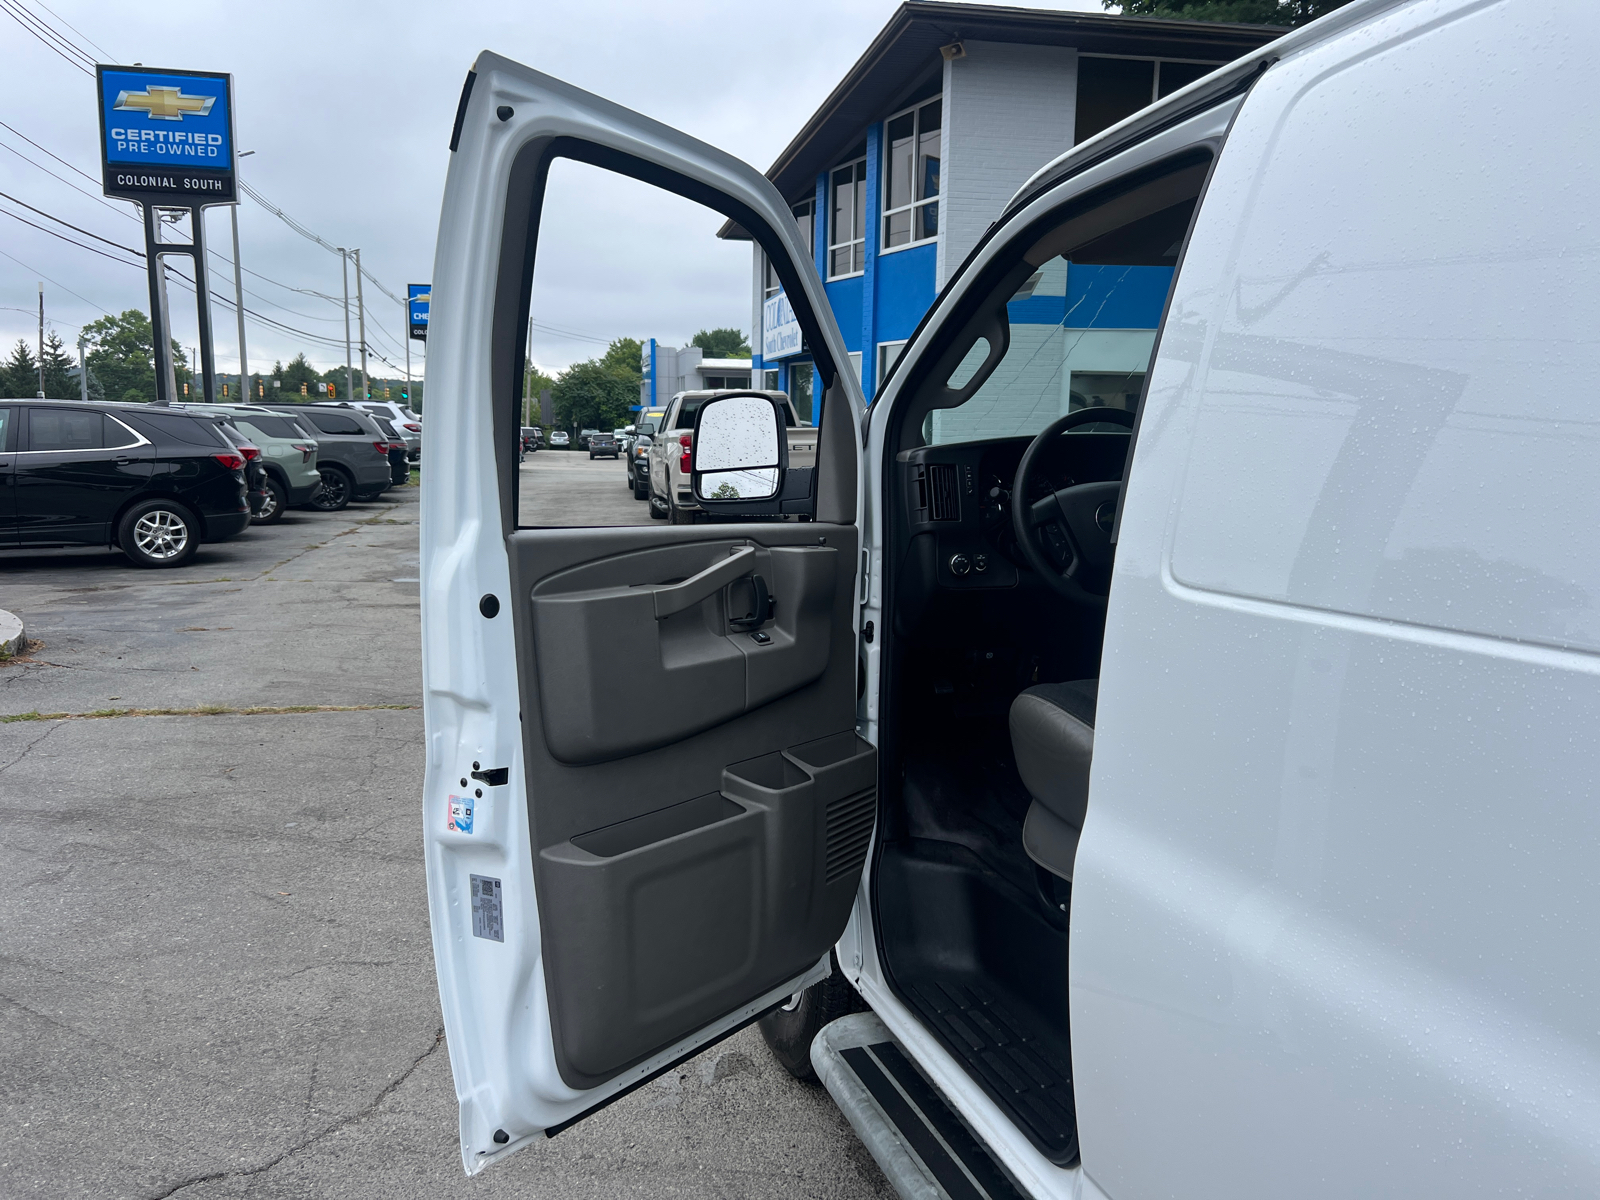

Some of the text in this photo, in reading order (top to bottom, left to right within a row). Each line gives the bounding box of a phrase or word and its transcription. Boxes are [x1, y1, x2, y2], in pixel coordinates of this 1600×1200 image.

[111, 128, 222, 145] CERTIFIED
[117, 141, 218, 157] PRE-OWNED
[117, 174, 222, 190] COLONIAL SOUTH
[776, 326, 798, 352] Chevrolet
